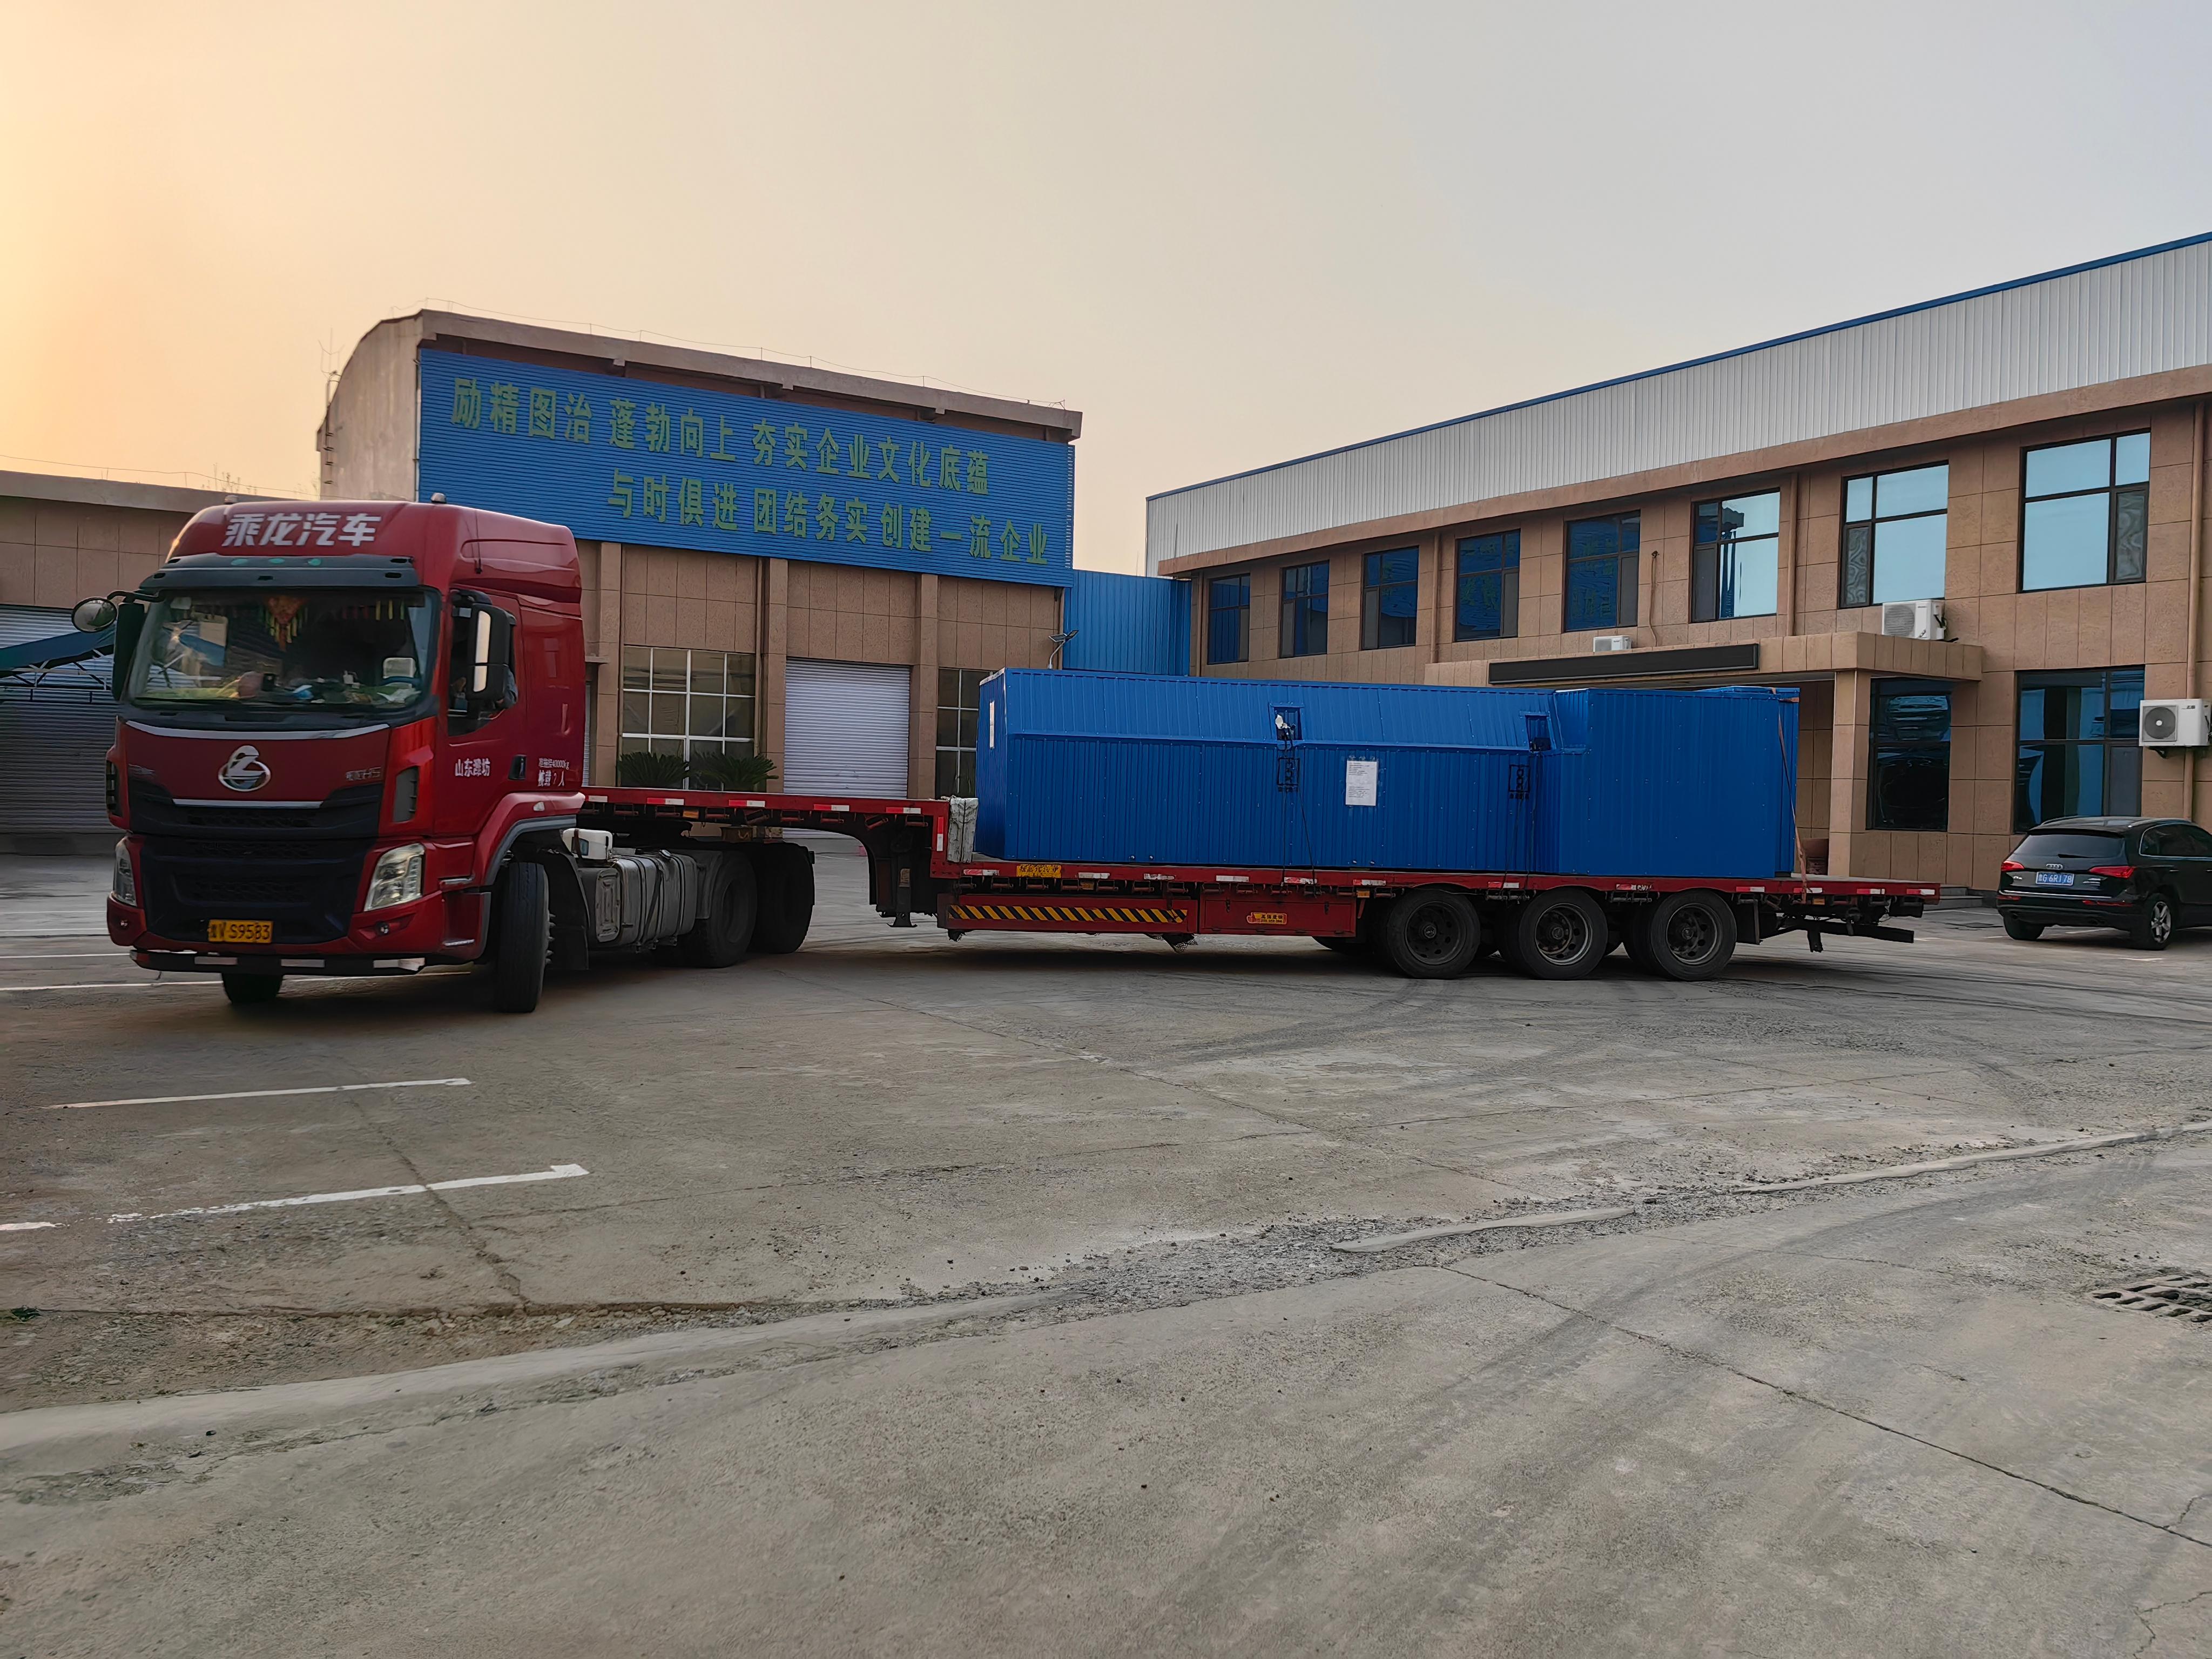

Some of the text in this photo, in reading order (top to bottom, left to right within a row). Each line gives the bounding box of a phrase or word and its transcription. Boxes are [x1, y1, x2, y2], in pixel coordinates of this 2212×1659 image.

[451, 378, 990, 495] 励精图治 蓬勃向上 夯实企业文化底蕴
[221, 512, 381, 547] 乘龙汽车
[608, 468, 1048, 565] 与时俱进 团结务实 创建一流企业
